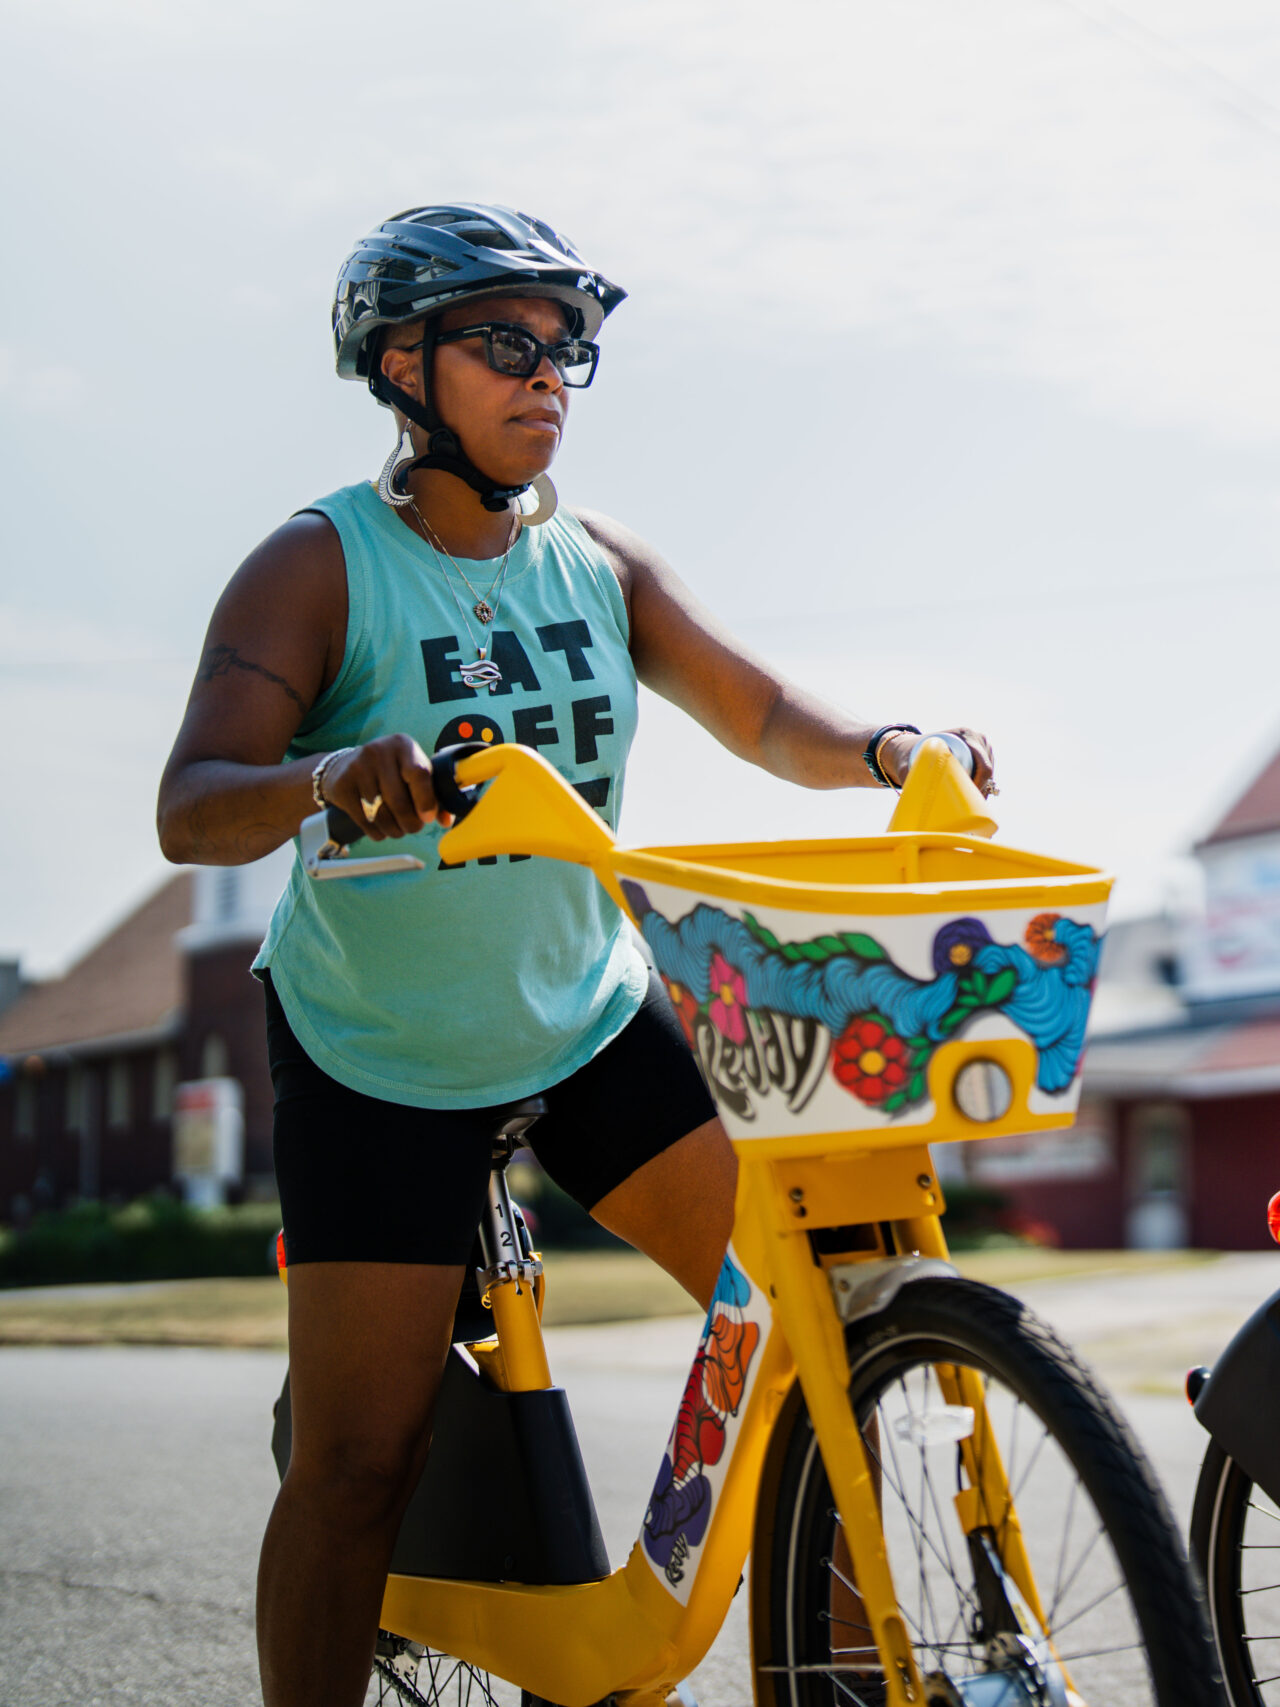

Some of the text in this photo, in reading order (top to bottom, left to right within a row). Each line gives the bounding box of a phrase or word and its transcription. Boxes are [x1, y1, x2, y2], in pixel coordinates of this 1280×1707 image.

[420, 619, 595, 704] EAT
[495, 1203, 503, 1218] 1
[500, 1231, 513, 1247] 2
